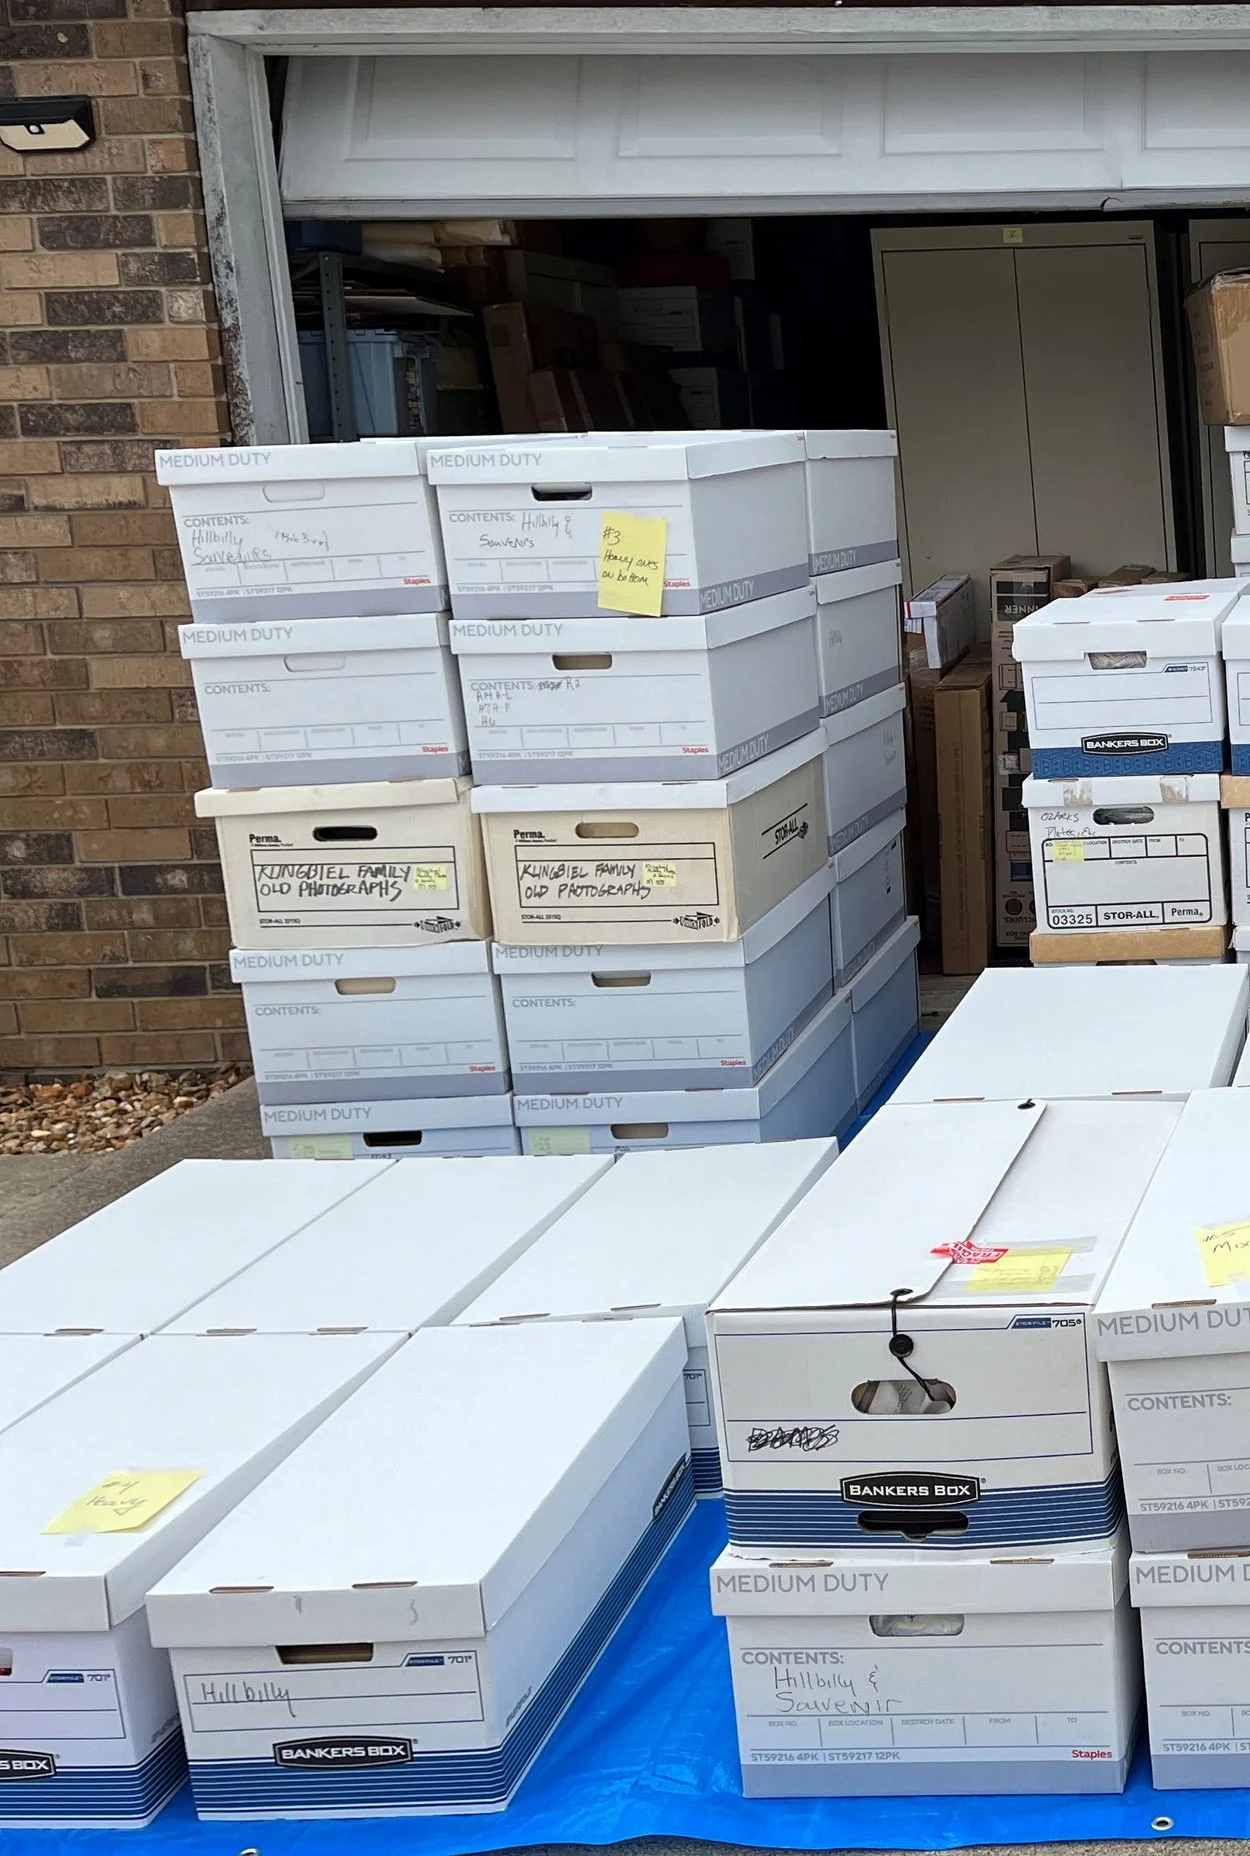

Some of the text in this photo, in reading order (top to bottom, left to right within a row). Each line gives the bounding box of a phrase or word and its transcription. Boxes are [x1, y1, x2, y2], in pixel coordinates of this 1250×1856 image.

[159, 452, 271, 468] MEDIUM DUTY
[430, 453, 542, 468] MEDIUM DUTY
[184, 516, 249, 528] CONTENTS:
[449, 512, 515, 523] CONTENTS:
[602, 526, 621, 546] #3
[663, 579, 691, 589] Staples
[733, 580, 753, 601] DUTY
[182, 626, 294, 643] MEDIUM DUTY
[453, 623, 563, 638] MEDIUM DUTY
[204, 684, 271, 694] CONTENTS:
[471, 681, 536, 691] CONTENTS:
[1086, 738, 1164, 749] BANKERS BOX
[682, 746, 709, 754] Staples
[1041, 812, 1079, 822] OZARKS
[358, 866, 411, 882] FAMILY
[520, 864, 588, 880] KLINGBIEL
[595, 863, 636, 879] FAMILY
[260, 880, 402, 901] OLD PHOTOGRAPHS
[525, 881, 651, 899] OLD PHOTOGRAPHS
[1104, 911, 1156, 920] STOR-ALL
[1171, 908, 1199, 916] Perma
[1052, 914, 1093, 925] 03325
[495, 945, 603, 959] MEDIUM DUTY
[233, 953, 344, 969] MEDIUM DUTY
[512, 998, 576, 1008] CONTENTS:
[255, 1007, 321, 1016] CONTENTS:
[720, 1059, 746, 1067] Staples
[517, 1097, 623, 1110] MEDIUM DUTY
[264, 1108, 372, 1123] MEDIUM DUTY
[1098, 1311, 1199, 1337] MEDIUM
[1127, 1394, 1232, 1411] CONTENTS:
[1173, 1467, 1187, 1475] NO.
[1217, 1464, 1232, 1472] BOX
[849, 1483, 970, 1497] BANKERS BOX
[1140, 1501, 1183, 1512] ST59216
[1186, 1500, 1209, 1510] 4PK
[1136, 1565, 1234, 1584] MEDIUM
[717, 1573, 888, 1593] MEDIUM DUTY
[741, 1651, 844, 1666] CONTENTS:
[774, 1666, 855, 1697] Hillbilly
[201, 1681, 296, 1718] Hillbilly
[775, 1691, 903, 1716] Souvenir
[844, 1719, 883, 1727] LOCATION
[988, 1717, 1011, 1725] FROM
[1066, 1716, 1077, 1724] TO
[281, 1745, 407, 1761] BANKERS BOX
[1162, 1743, 1206, 1752] ST59216
[1208, 1742, 1230, 1751] 4PK
[751, 1751, 900, 1763] ST59216 4PK ST59217 12PK
[1071, 1749, 1113, 1760] Staples
[13, 1761, 49, 1770] BOX
